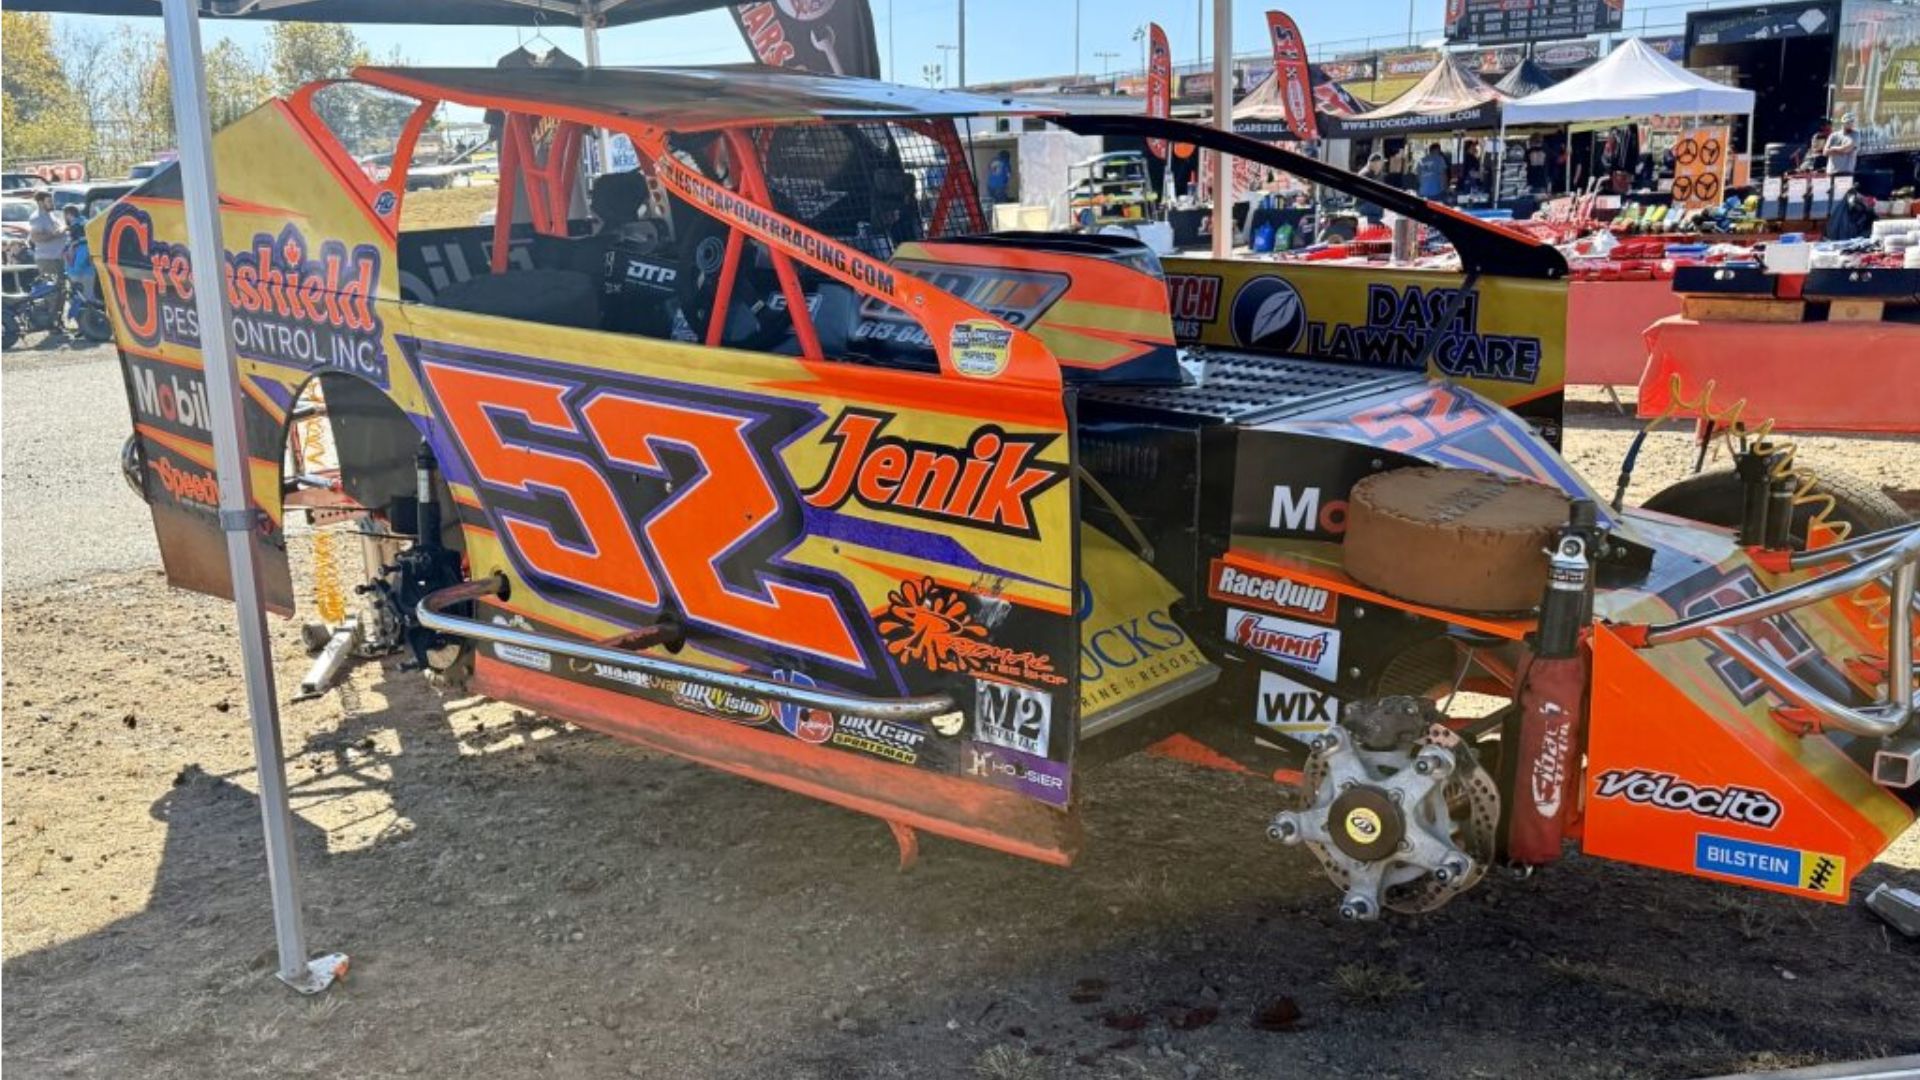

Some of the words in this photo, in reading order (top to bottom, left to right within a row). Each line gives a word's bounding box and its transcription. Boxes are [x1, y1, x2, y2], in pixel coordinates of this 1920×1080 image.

[738, 0, 795, 66] ARS
[107, 214, 376, 339] Greshield
[1369, 284, 1479, 334] DASH
[162, 304, 200, 337] PES
[232, 317, 326, 364] ONTROL
[331, 329, 383, 374] INC.
[1435, 334, 1541, 383] CARE
[802, 413, 1057, 530] Jenik
[421, 361, 866, 672] 52
[1218, 567, 1329, 613] RaceQuip
[1263, 692, 1332, 722] WIX
[1708, 846, 1789, 875] BILSTEIN
